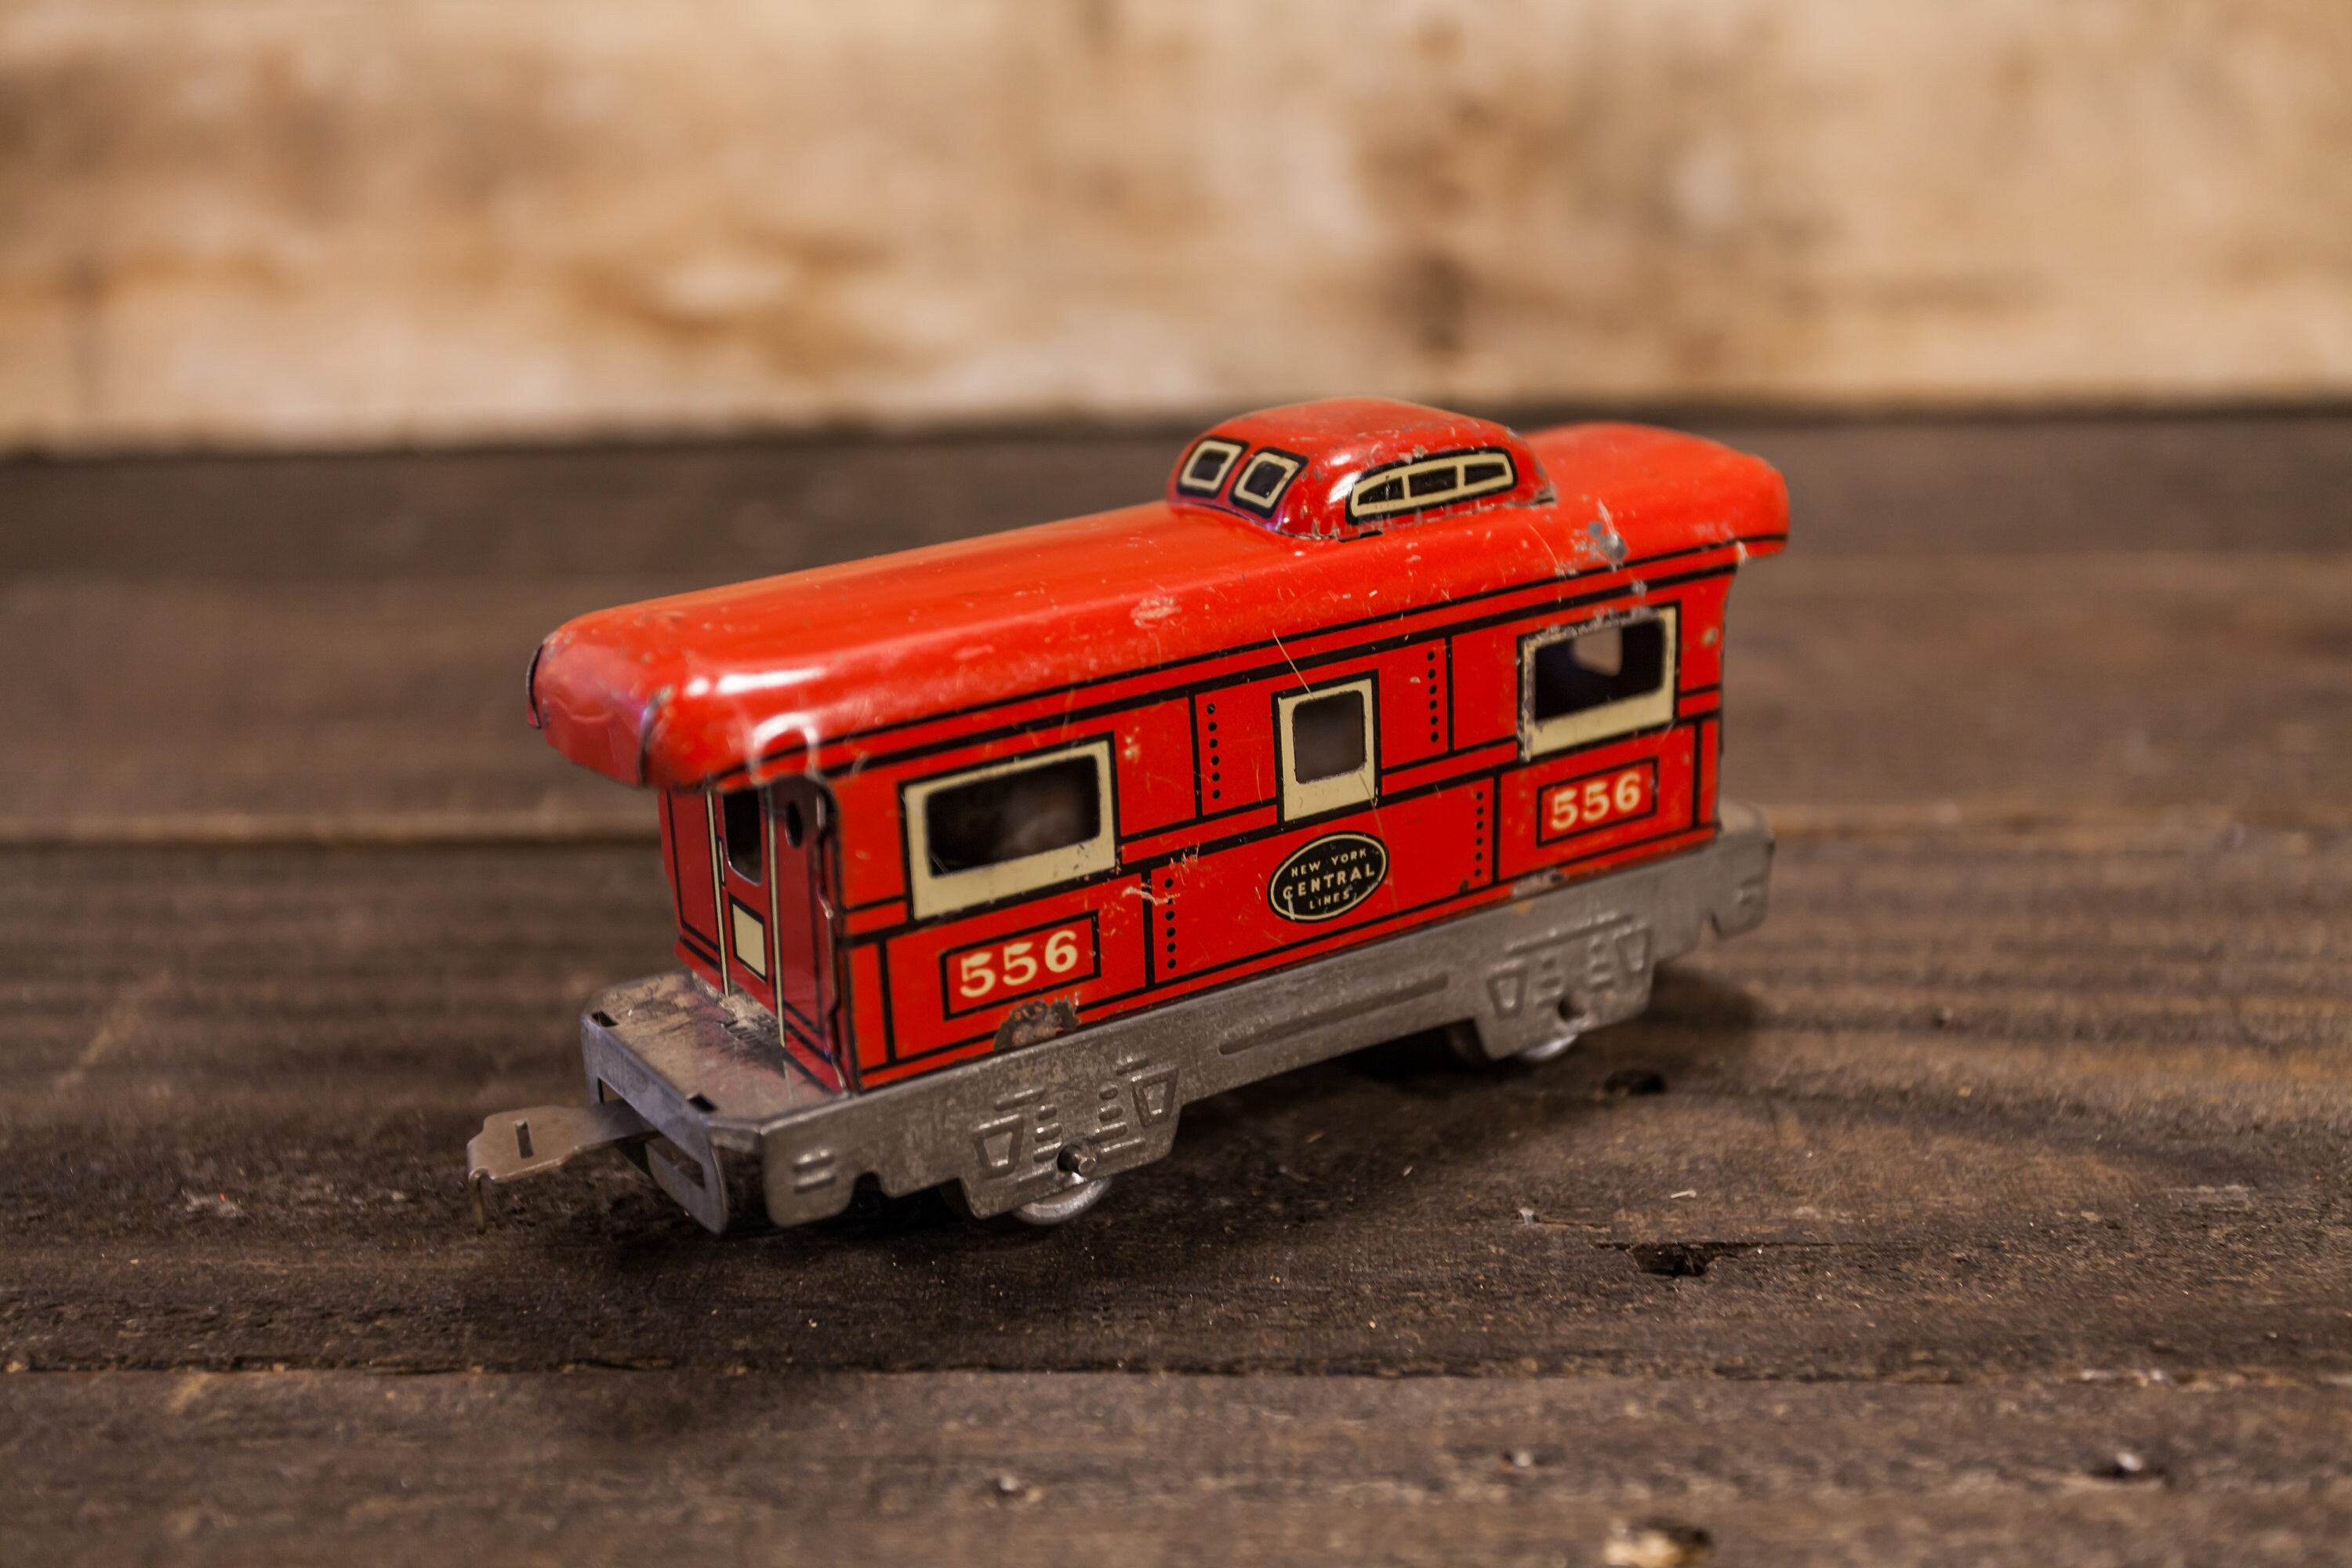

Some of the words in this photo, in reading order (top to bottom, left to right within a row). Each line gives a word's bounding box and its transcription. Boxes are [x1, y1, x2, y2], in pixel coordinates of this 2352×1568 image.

[1548, 771, 1641, 830] 556
[1291, 861, 1320, 877] NEW
[1331, 848, 1367, 866] YORK
[1283, 863, 1375, 901] CENTRAL
[1309, 890, 1350, 909] LINES
[960, 930, 1078, 998] 556
